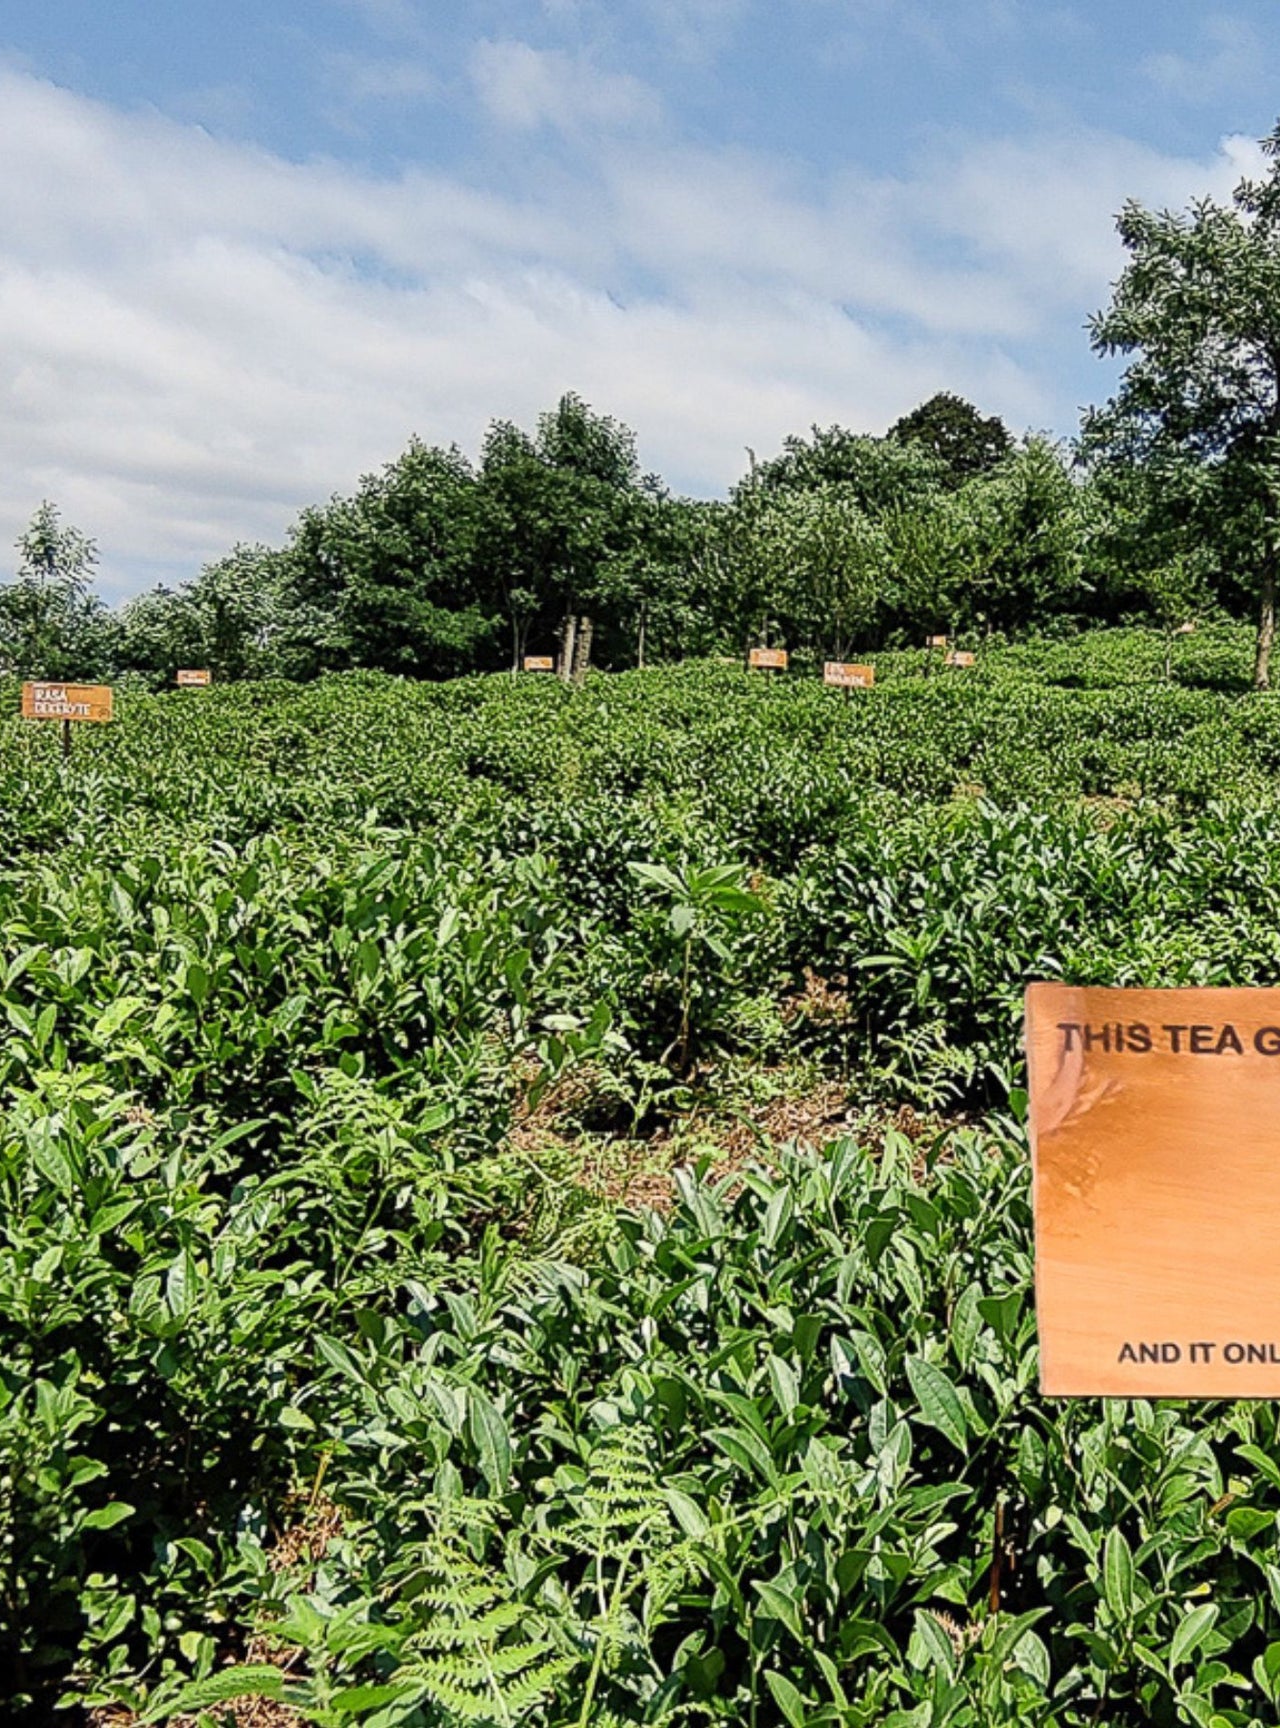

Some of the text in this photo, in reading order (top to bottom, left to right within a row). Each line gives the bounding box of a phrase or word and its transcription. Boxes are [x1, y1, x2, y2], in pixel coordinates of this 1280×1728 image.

[1057, 1022, 1152, 1054] THIS
[1162, 1024, 1242, 1055] TEA
[1118, 1342, 1181, 1364] AND
[1189, 1343, 1216, 1364] IT
